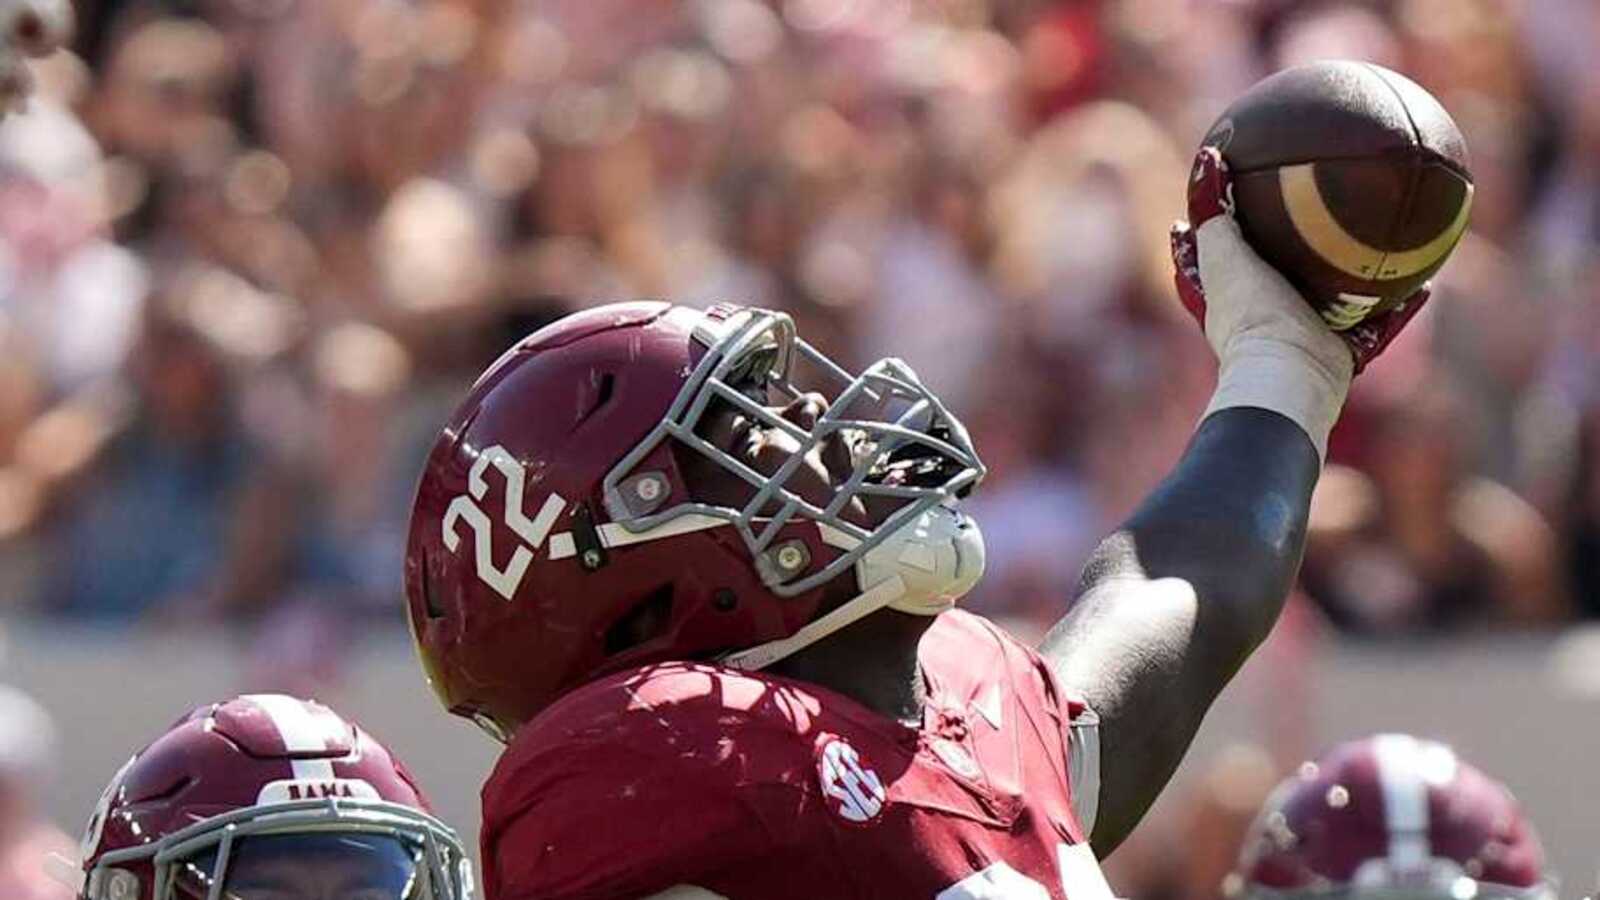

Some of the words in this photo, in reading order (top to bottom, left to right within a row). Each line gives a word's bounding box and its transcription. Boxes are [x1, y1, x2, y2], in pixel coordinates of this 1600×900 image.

[442, 444, 567, 600] 22
[288, 783, 353, 800] BAMA
[822, 741, 885, 821] SEC
